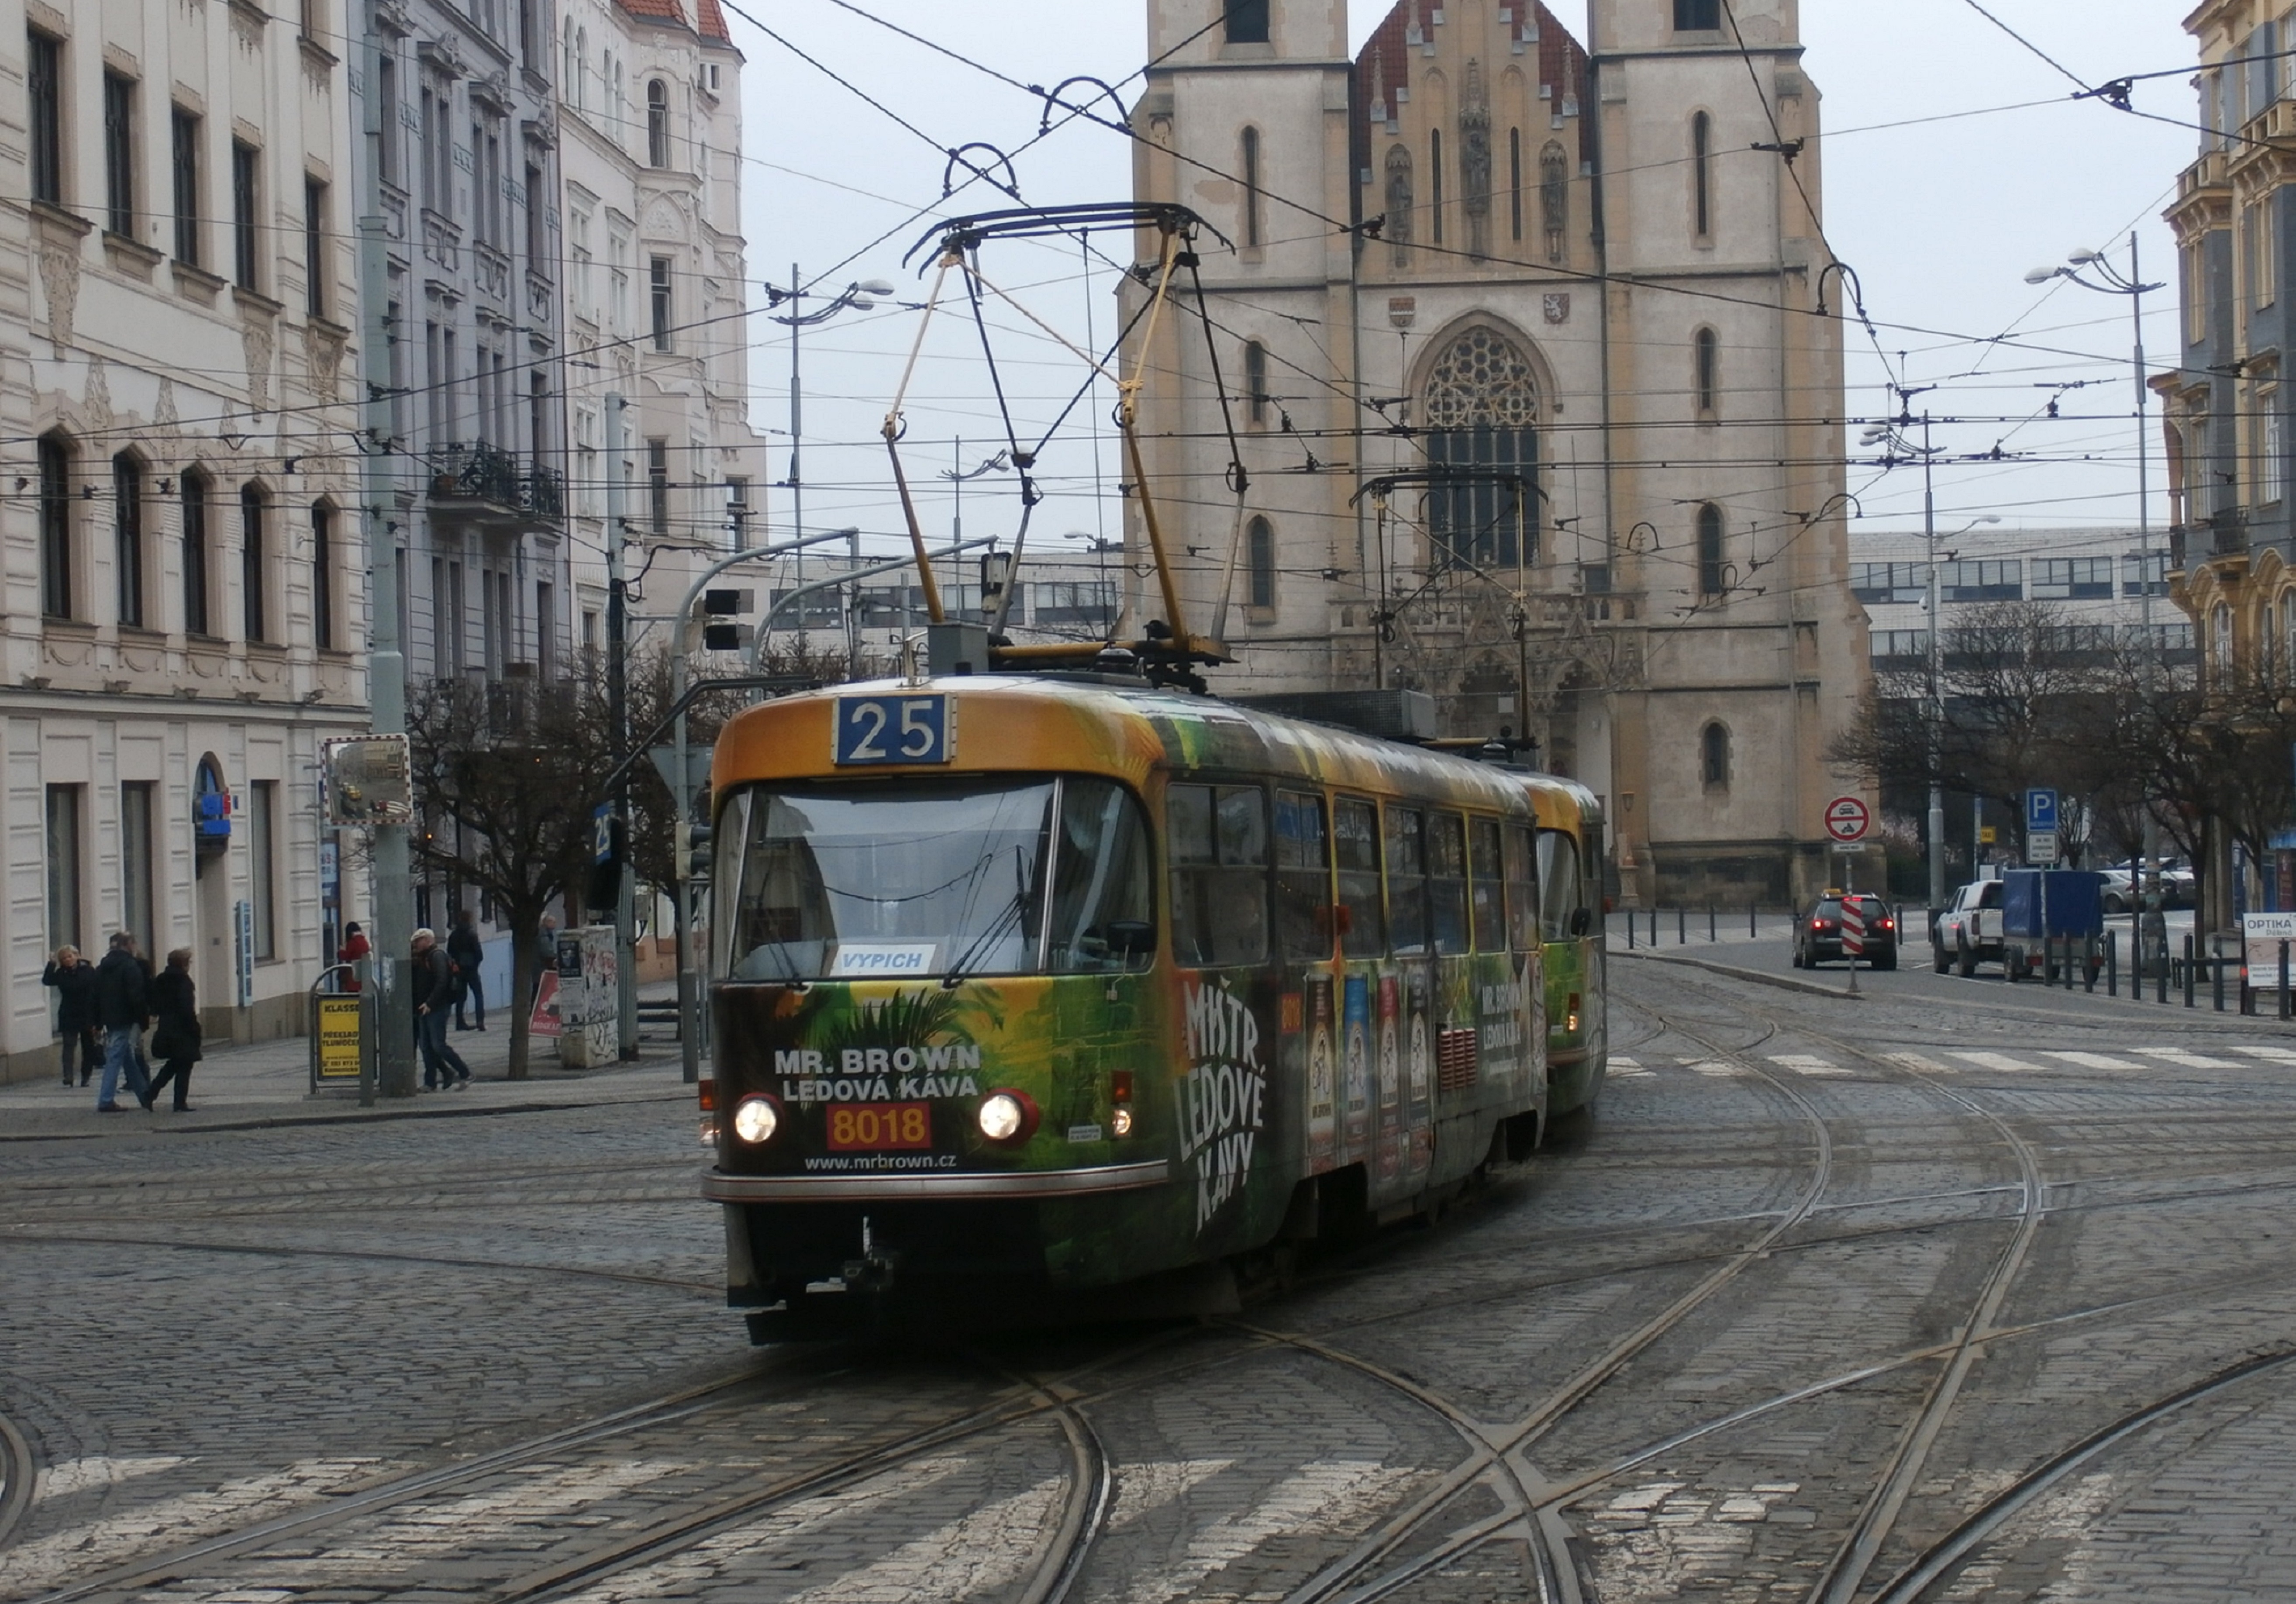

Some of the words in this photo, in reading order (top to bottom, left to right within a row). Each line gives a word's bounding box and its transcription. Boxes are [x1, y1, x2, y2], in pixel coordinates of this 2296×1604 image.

[849, 700, 934, 759] 25
[2034, 794, 2051, 818] P
[2248, 919, 2292, 929] OPTIKA
[842, 953, 922, 968] VYPICH
[775, 1050, 834, 1073] MR.
[842, 1045, 981, 1074] BROWN
[784, 1076, 889, 1101] LEDOVÁ
[898, 1072, 978, 1099] KÁVA
[833, 1108, 925, 1144] 8018
[1174, 1064, 1266, 1163] LEDOVÉ
[805, 1153, 956, 1170] www.mrbrown.cz
